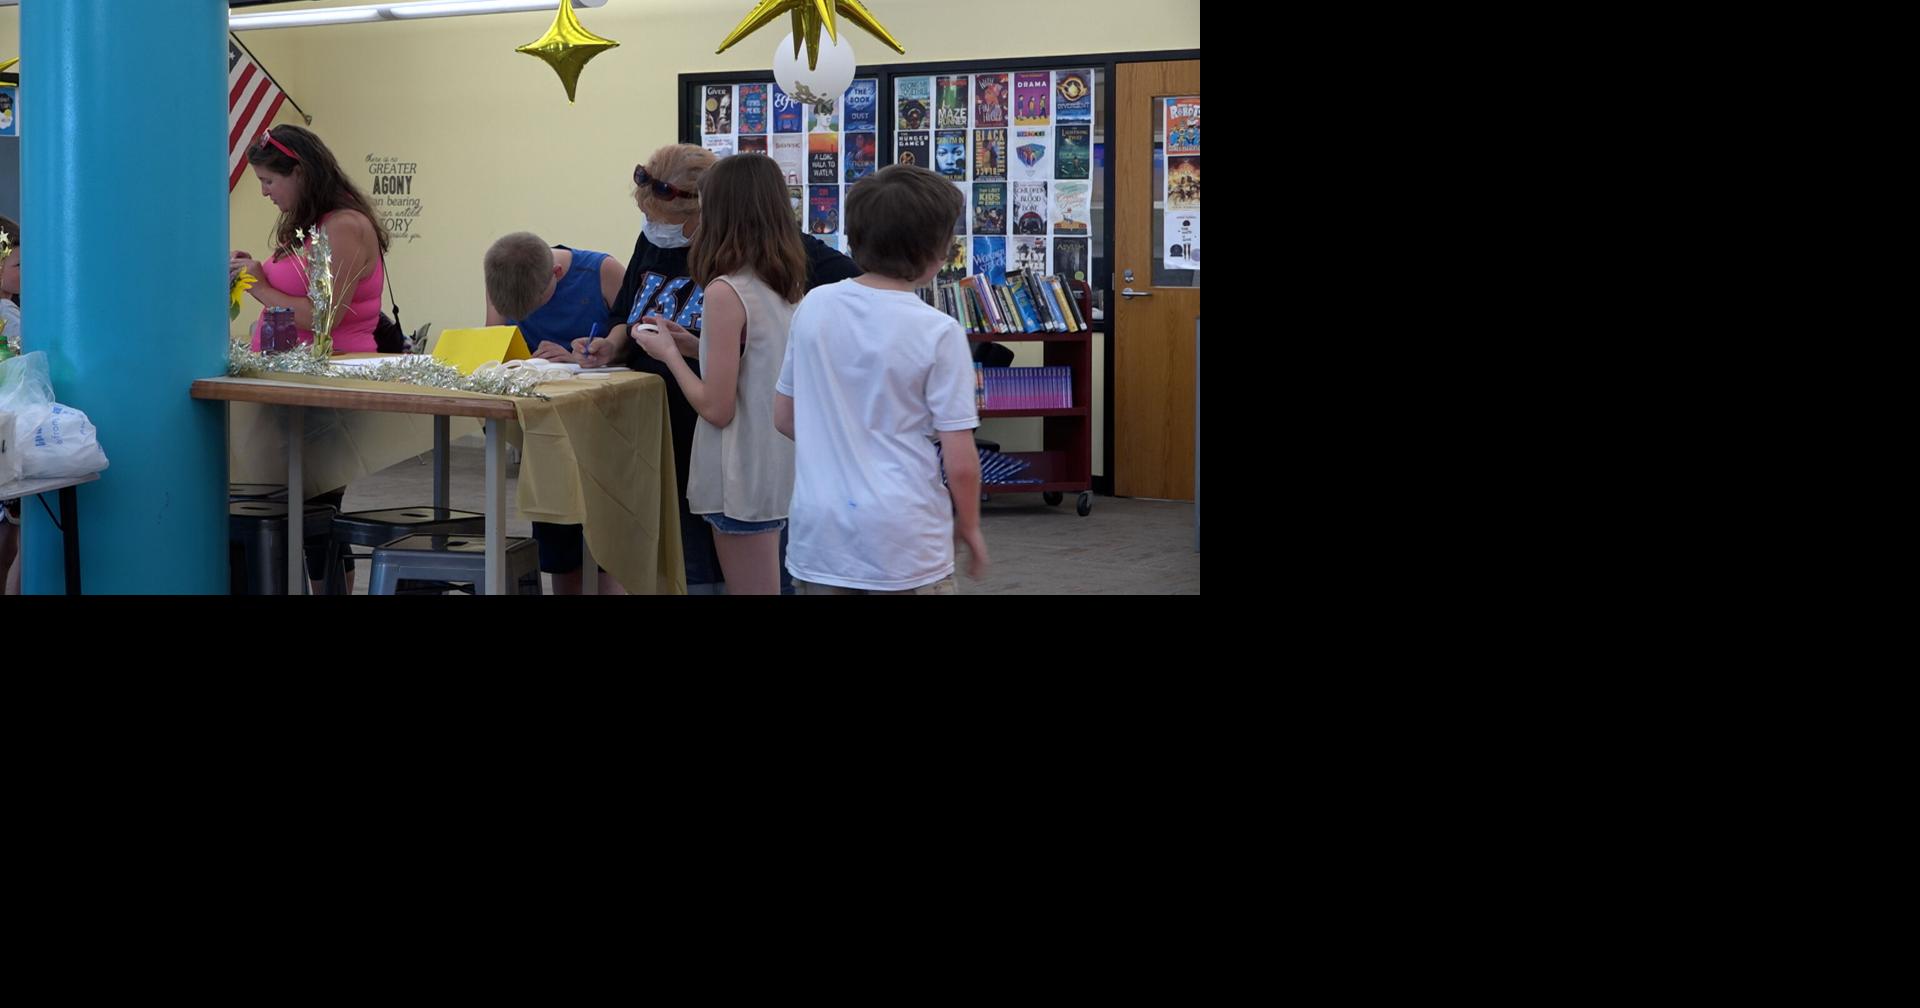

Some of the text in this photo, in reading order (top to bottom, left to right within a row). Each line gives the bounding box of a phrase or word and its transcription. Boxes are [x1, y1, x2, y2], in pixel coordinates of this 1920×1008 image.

[938, 108, 967, 118] MAZE
[976, 130, 1005, 141] BLACK
[368, 163, 417, 174] GREATER
[373, 175, 412, 195] AGONY
[387, 195, 420, 208] bearing
[979, 192, 1000, 201] KIDS
[380, 217, 413, 231] TORY
